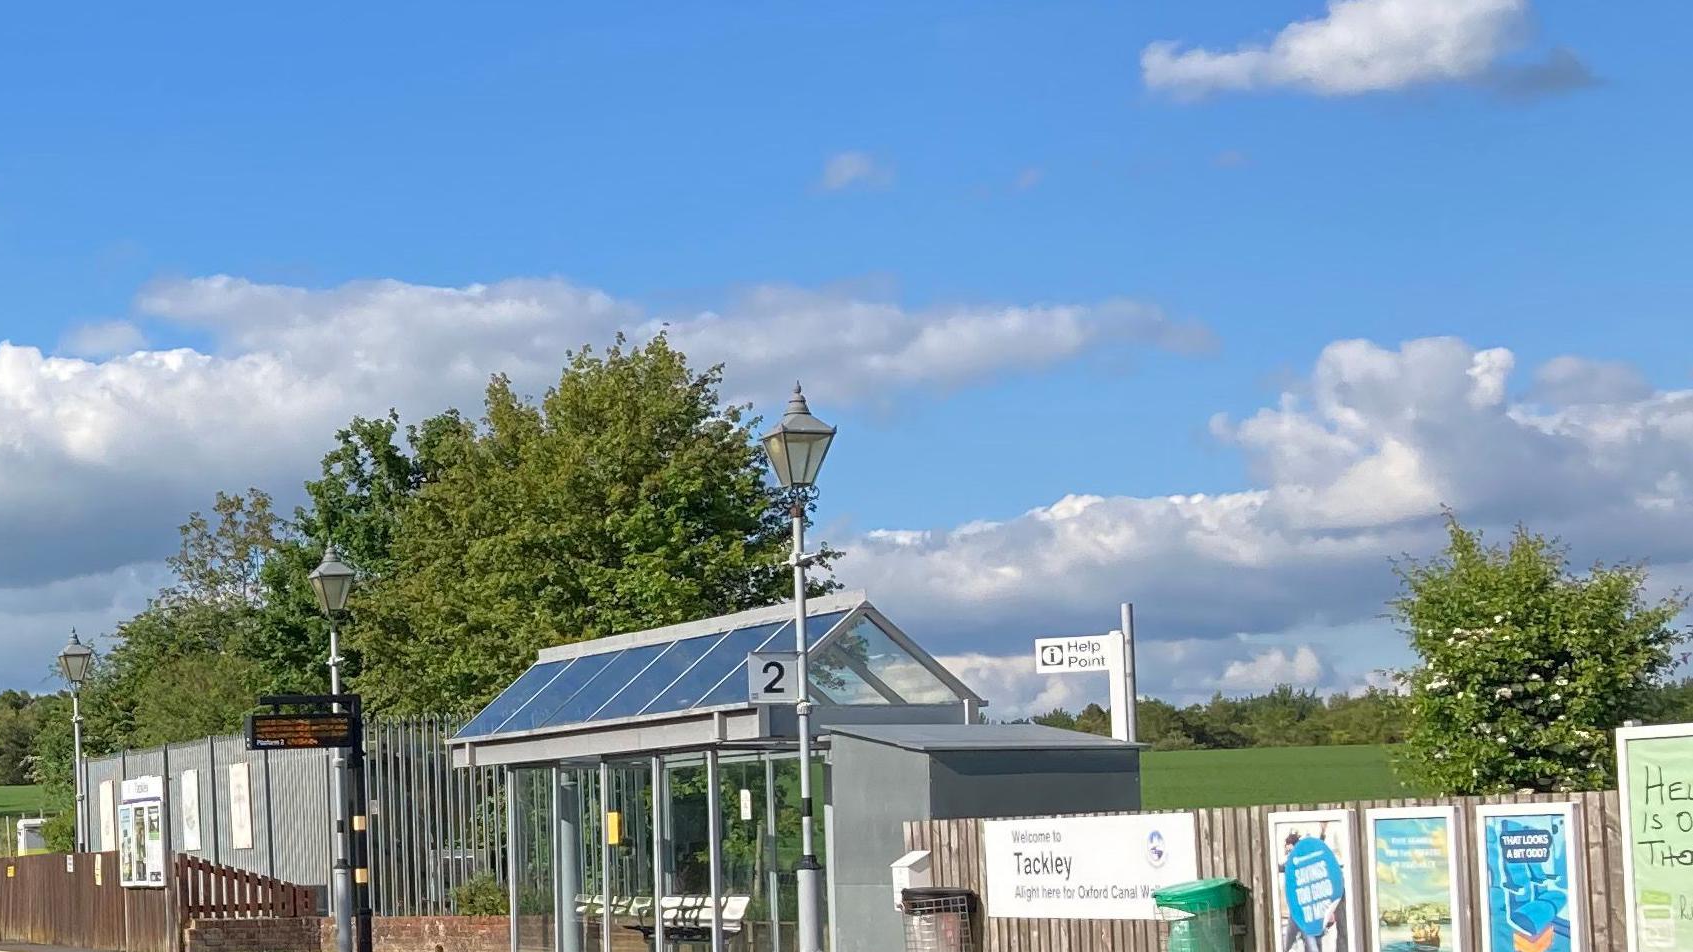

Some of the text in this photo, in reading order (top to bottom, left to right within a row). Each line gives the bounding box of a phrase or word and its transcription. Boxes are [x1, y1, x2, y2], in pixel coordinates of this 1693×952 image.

[1068, 641, 1101, 654] Help
[1068, 656, 1106, 667] Point
[762, 661, 785, 693] 2
[1642, 812, 1663, 834] IS
[1011, 830, 1062, 844] Welcome to
[1501, 834, 1549, 846] THAT LOOKS
[1506, 848, 1514, 858] A
[1514, 848, 1526, 858] BIT
[1014, 851, 1072, 880] Tackley
[1015, 885, 1040, 901] Alight
[1041, 885, 1061, 899] here
[1062, 884, 1076, 899] for
[1077, 884, 1109, 899] Oxford
[1110, 883, 1138, 899] Canal
